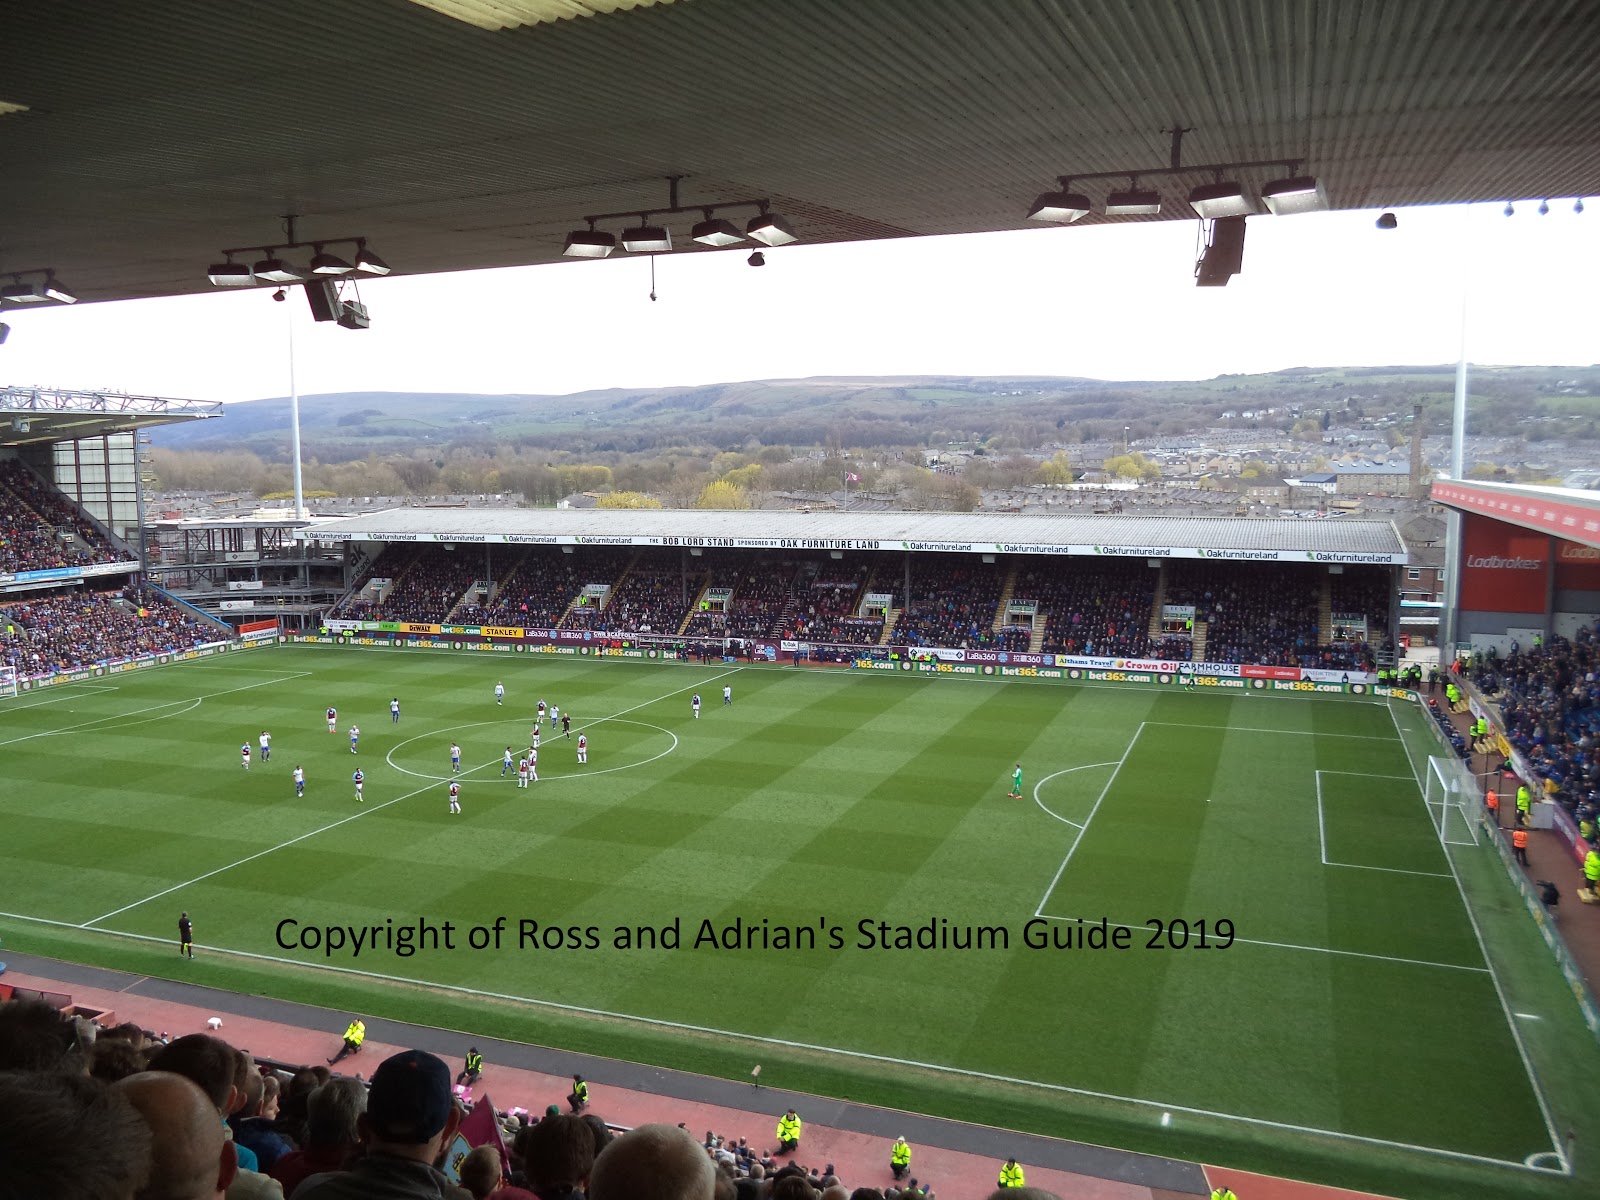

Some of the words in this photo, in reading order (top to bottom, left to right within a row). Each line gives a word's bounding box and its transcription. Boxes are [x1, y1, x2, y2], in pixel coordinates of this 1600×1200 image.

[309, 532, 351, 540] Oakfurnitureland
[372, 533, 416, 541] Oakfurnitureland
[663, 537, 679, 546] BOB
[682, 538, 704, 546] LORD
[707, 538, 734, 547] STAND
[780, 540, 798, 548] OAK
[802, 541, 852, 549] FURNITURE
[856, 541, 880, 549] LAND
[910, 543, 972, 551] Oakfurnitureland
[1004, 545, 1068, 554] Oakfurnitureland
[1102, 547, 1171, 556] Oakfurnitureland
[1206, 550, 1278, 560] Oakfurnitureland
[1316, 552, 1392, 563] Oakfurnitureland
[1466, 554, 1541, 570] Ladbrokes
[441, 626, 480, 634] bet365.com
[486, 628, 518, 636] STANLEY
[231, 639, 273, 650] bet365.com
[350, 638, 389, 646] bet365.com
[407, 640, 449, 649] bet365.com
[467, 643, 510, 652] bet365.com
[529, 645, 575, 654] bet365.com
[173, 648, 214, 661] bet365.com
[966, 652, 996, 661] LaBa360
[1059, 657, 1088, 665] Althams
[1125, 660, 1158, 670] Crown
[1161, 661, 1177, 671] Oil
[109, 660, 155, 673] bet365.com
[1179, 662, 1239, 674] FARMHOUSE
[1002, 666, 1061, 677] bet365.com
[38, 672, 89, 687] bet365.com
[1088, 671, 1150, 682] bet365.com
[1274, 681, 1342, 692] bet365.com
